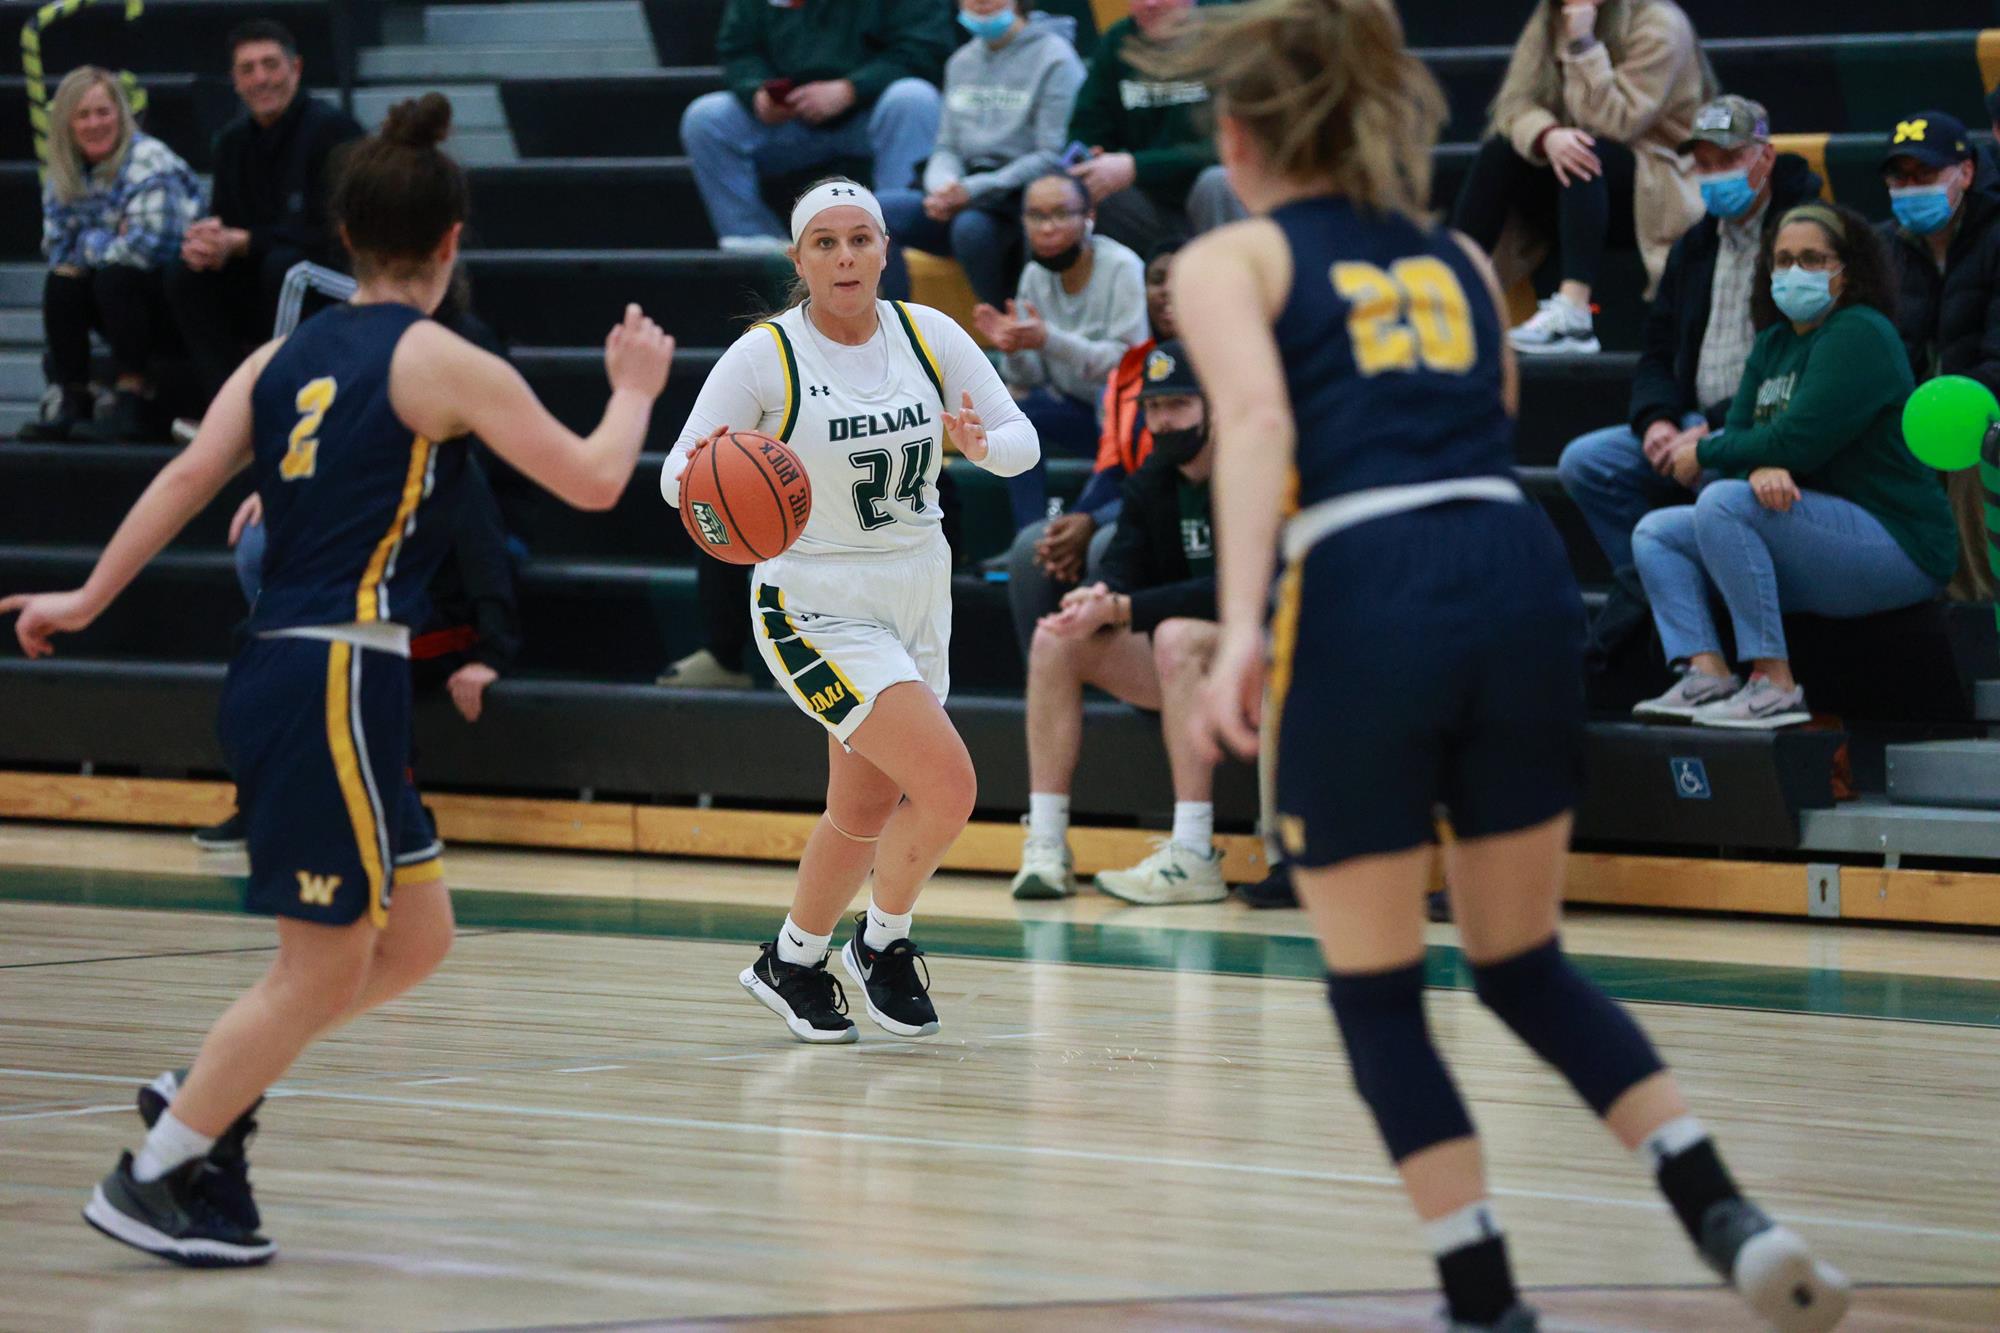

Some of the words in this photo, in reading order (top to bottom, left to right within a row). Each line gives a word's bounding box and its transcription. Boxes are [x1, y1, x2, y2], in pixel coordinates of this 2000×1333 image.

[1893, 118, 1929, 144] M
[1329, 255, 1477, 377] 20
[279, 376, 337, 482] 2
[828, 402, 931, 442] DELVAL
[759, 441, 800, 488] ROCK
[849, 437, 933, 531] 24
[693, 504, 720, 544] MAC
[296, 869, 342, 907] W
